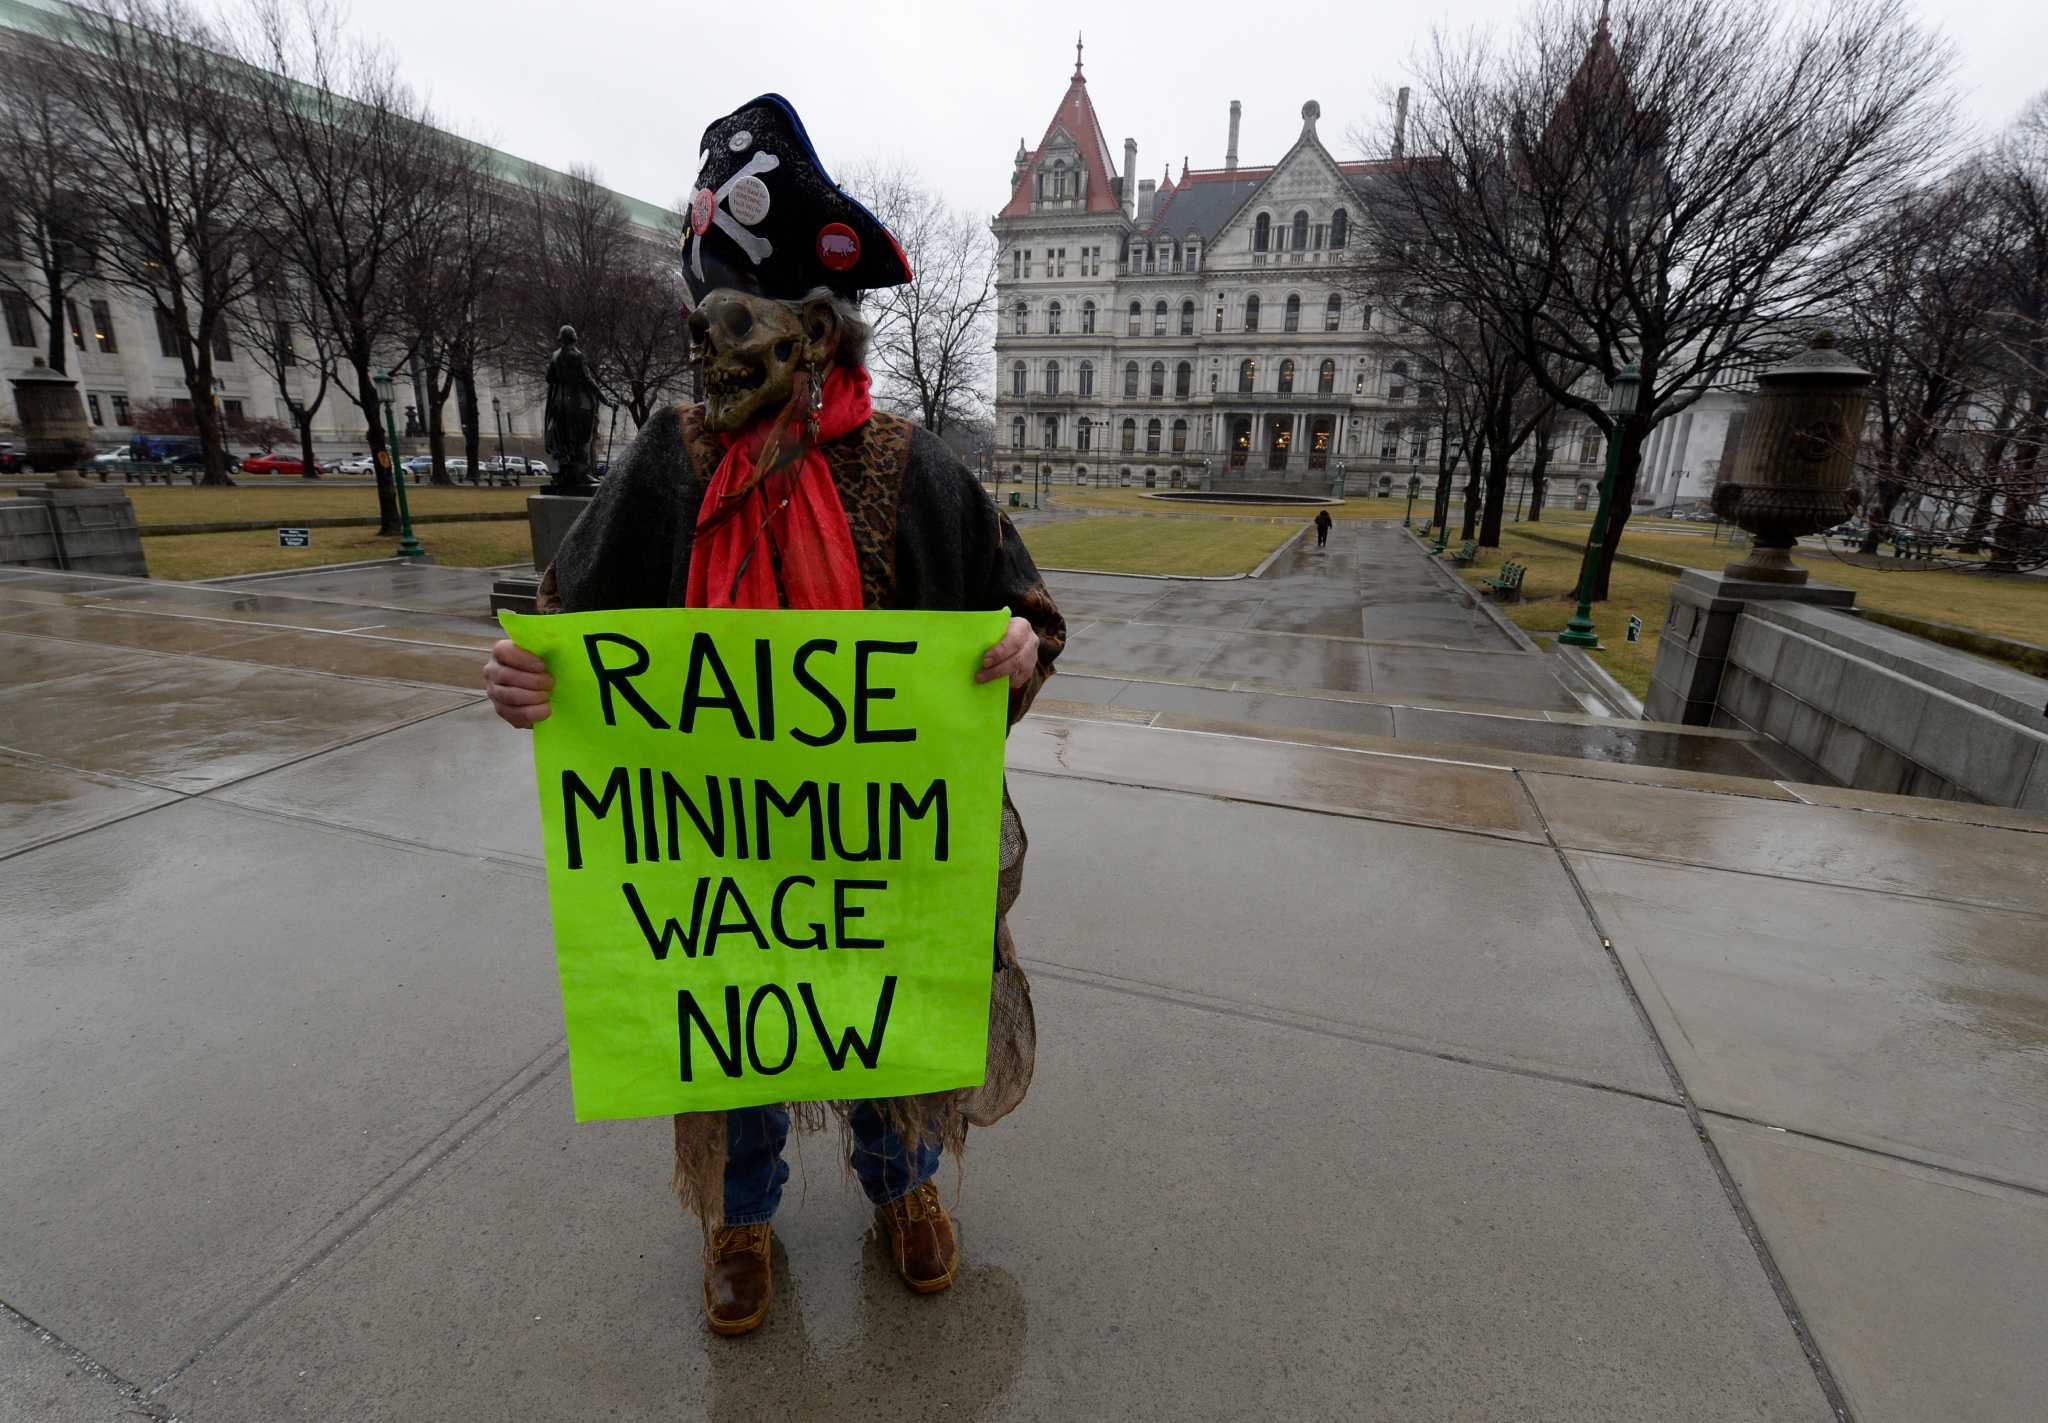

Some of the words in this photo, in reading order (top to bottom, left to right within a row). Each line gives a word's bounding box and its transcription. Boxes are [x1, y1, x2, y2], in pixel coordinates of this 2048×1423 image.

[583, 632, 918, 748] RAISE
[561, 767, 949, 870] MINIMUM
[622, 876, 888, 960] WAGE
[677, 976, 898, 1083] NOW
